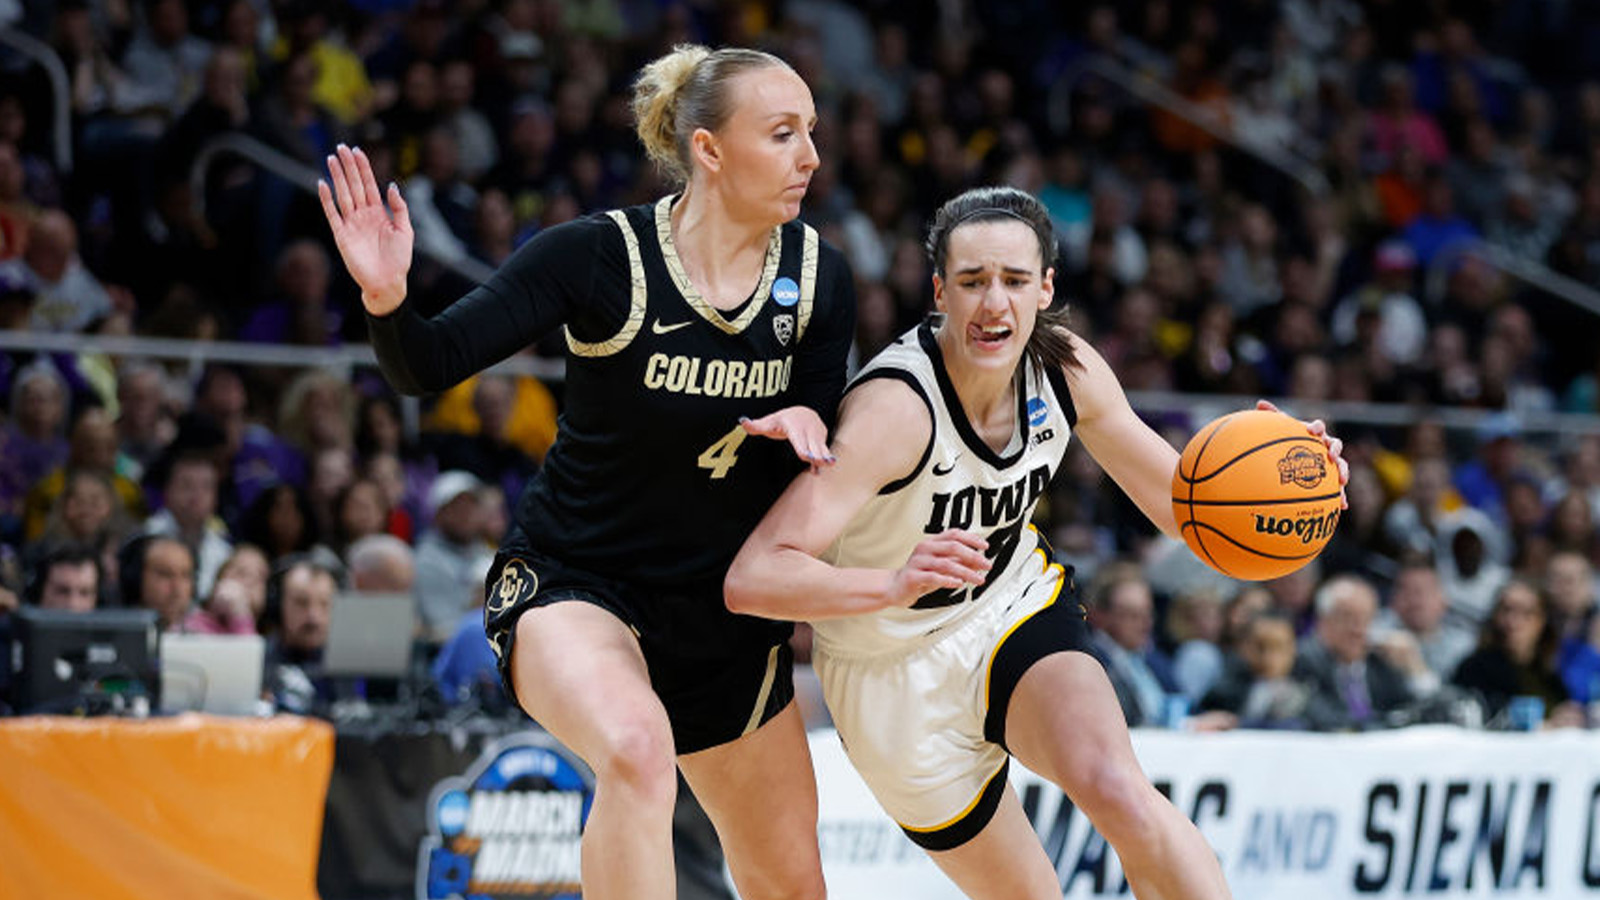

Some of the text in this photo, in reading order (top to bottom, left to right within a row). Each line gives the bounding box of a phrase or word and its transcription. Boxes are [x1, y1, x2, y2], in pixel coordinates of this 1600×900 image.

[644, 353, 793, 398] COLORADO
[697, 424, 749, 479] 4
[1255, 507, 1341, 545] Wilson
[465, 788, 583, 836] MARCH
[472, 836, 582, 884] MADN
[1240, 811, 1338, 874] AND
[1354, 781, 1552, 894] SIENA
